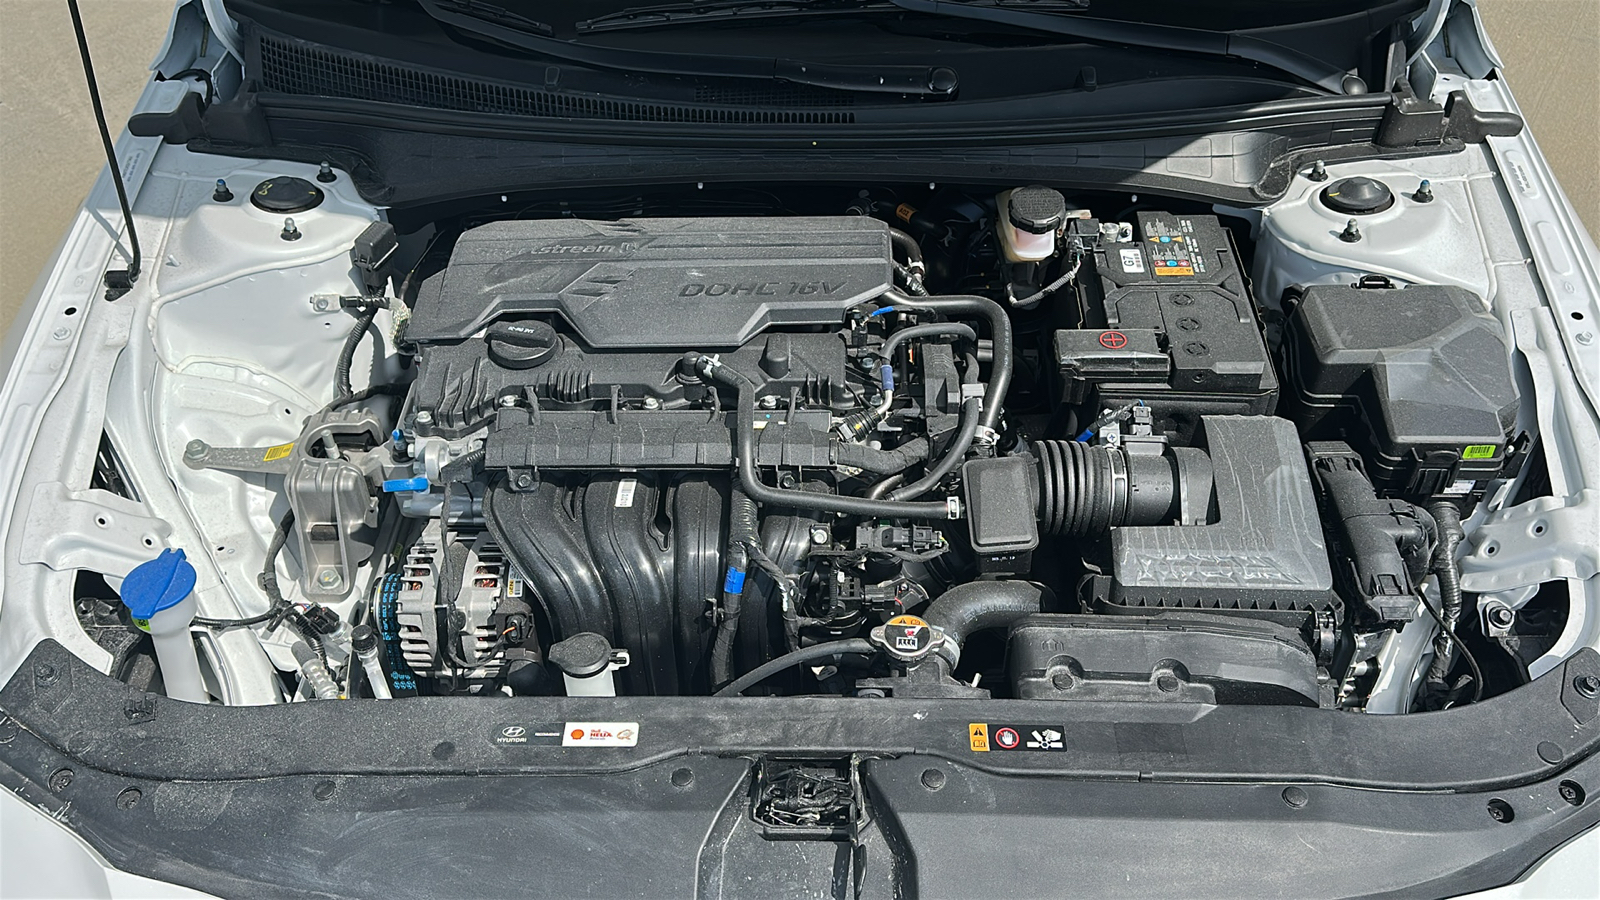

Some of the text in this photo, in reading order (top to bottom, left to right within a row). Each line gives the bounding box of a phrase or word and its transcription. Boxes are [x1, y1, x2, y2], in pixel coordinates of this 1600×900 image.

[1123, 255, 1135, 267] G7
[678, 281, 847, 298] DOHC 16V
